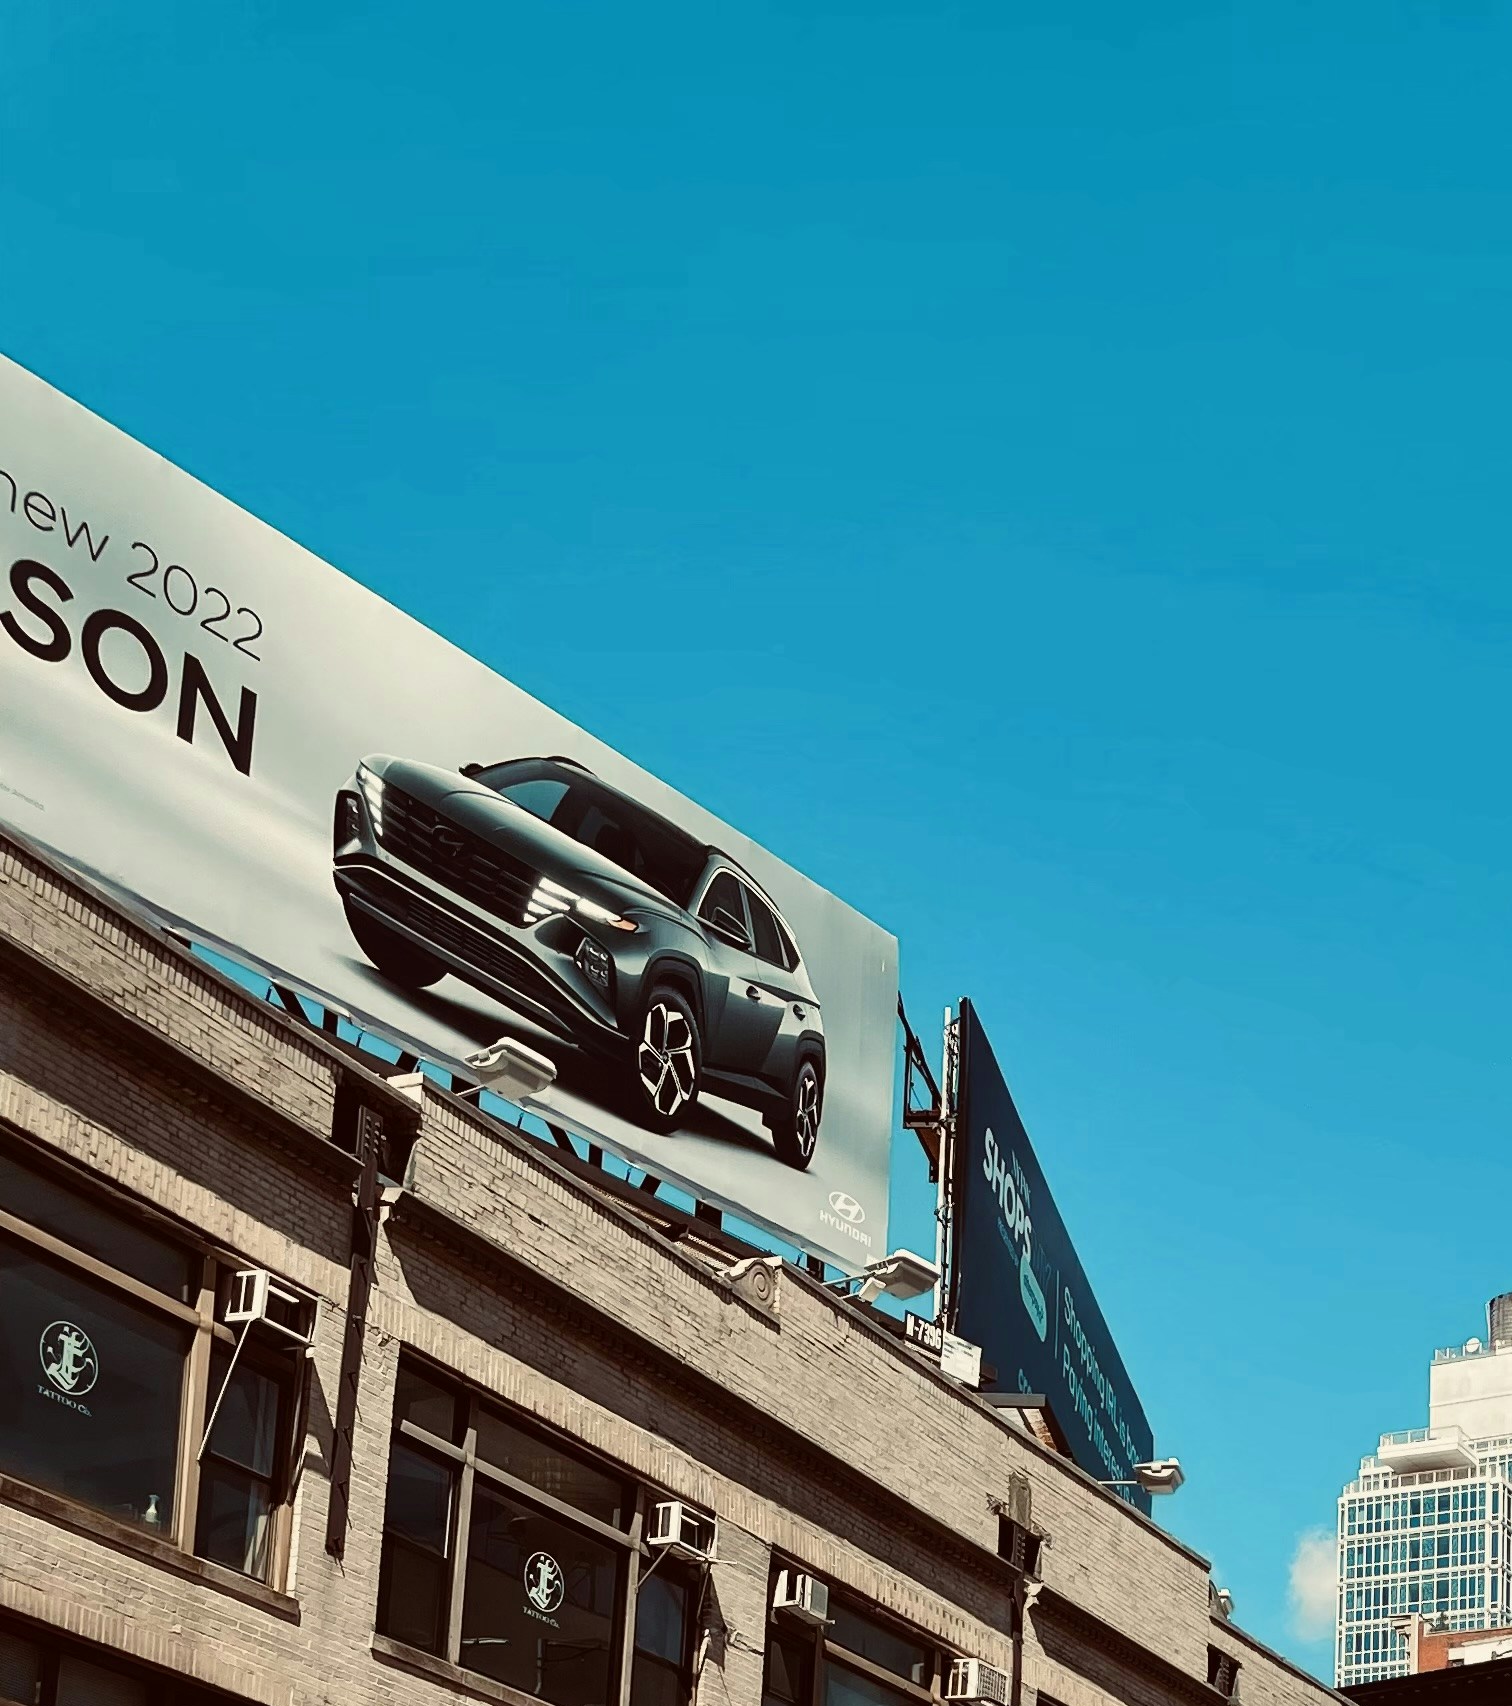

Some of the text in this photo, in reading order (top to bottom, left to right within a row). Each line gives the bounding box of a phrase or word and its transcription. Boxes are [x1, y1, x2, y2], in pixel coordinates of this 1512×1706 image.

[126, 541, 262, 662] 2022
[0, 559, 258, 778] SON
[983, 1127, 1032, 1265] SHOPS
[819, 1209, 872, 1248] HYUNDAI
[906, 1313, 942, 1350] M-7396
[37, 1384, 77, 1409] TATTOO
[522, 1605, 550, 1624] TATTOO
